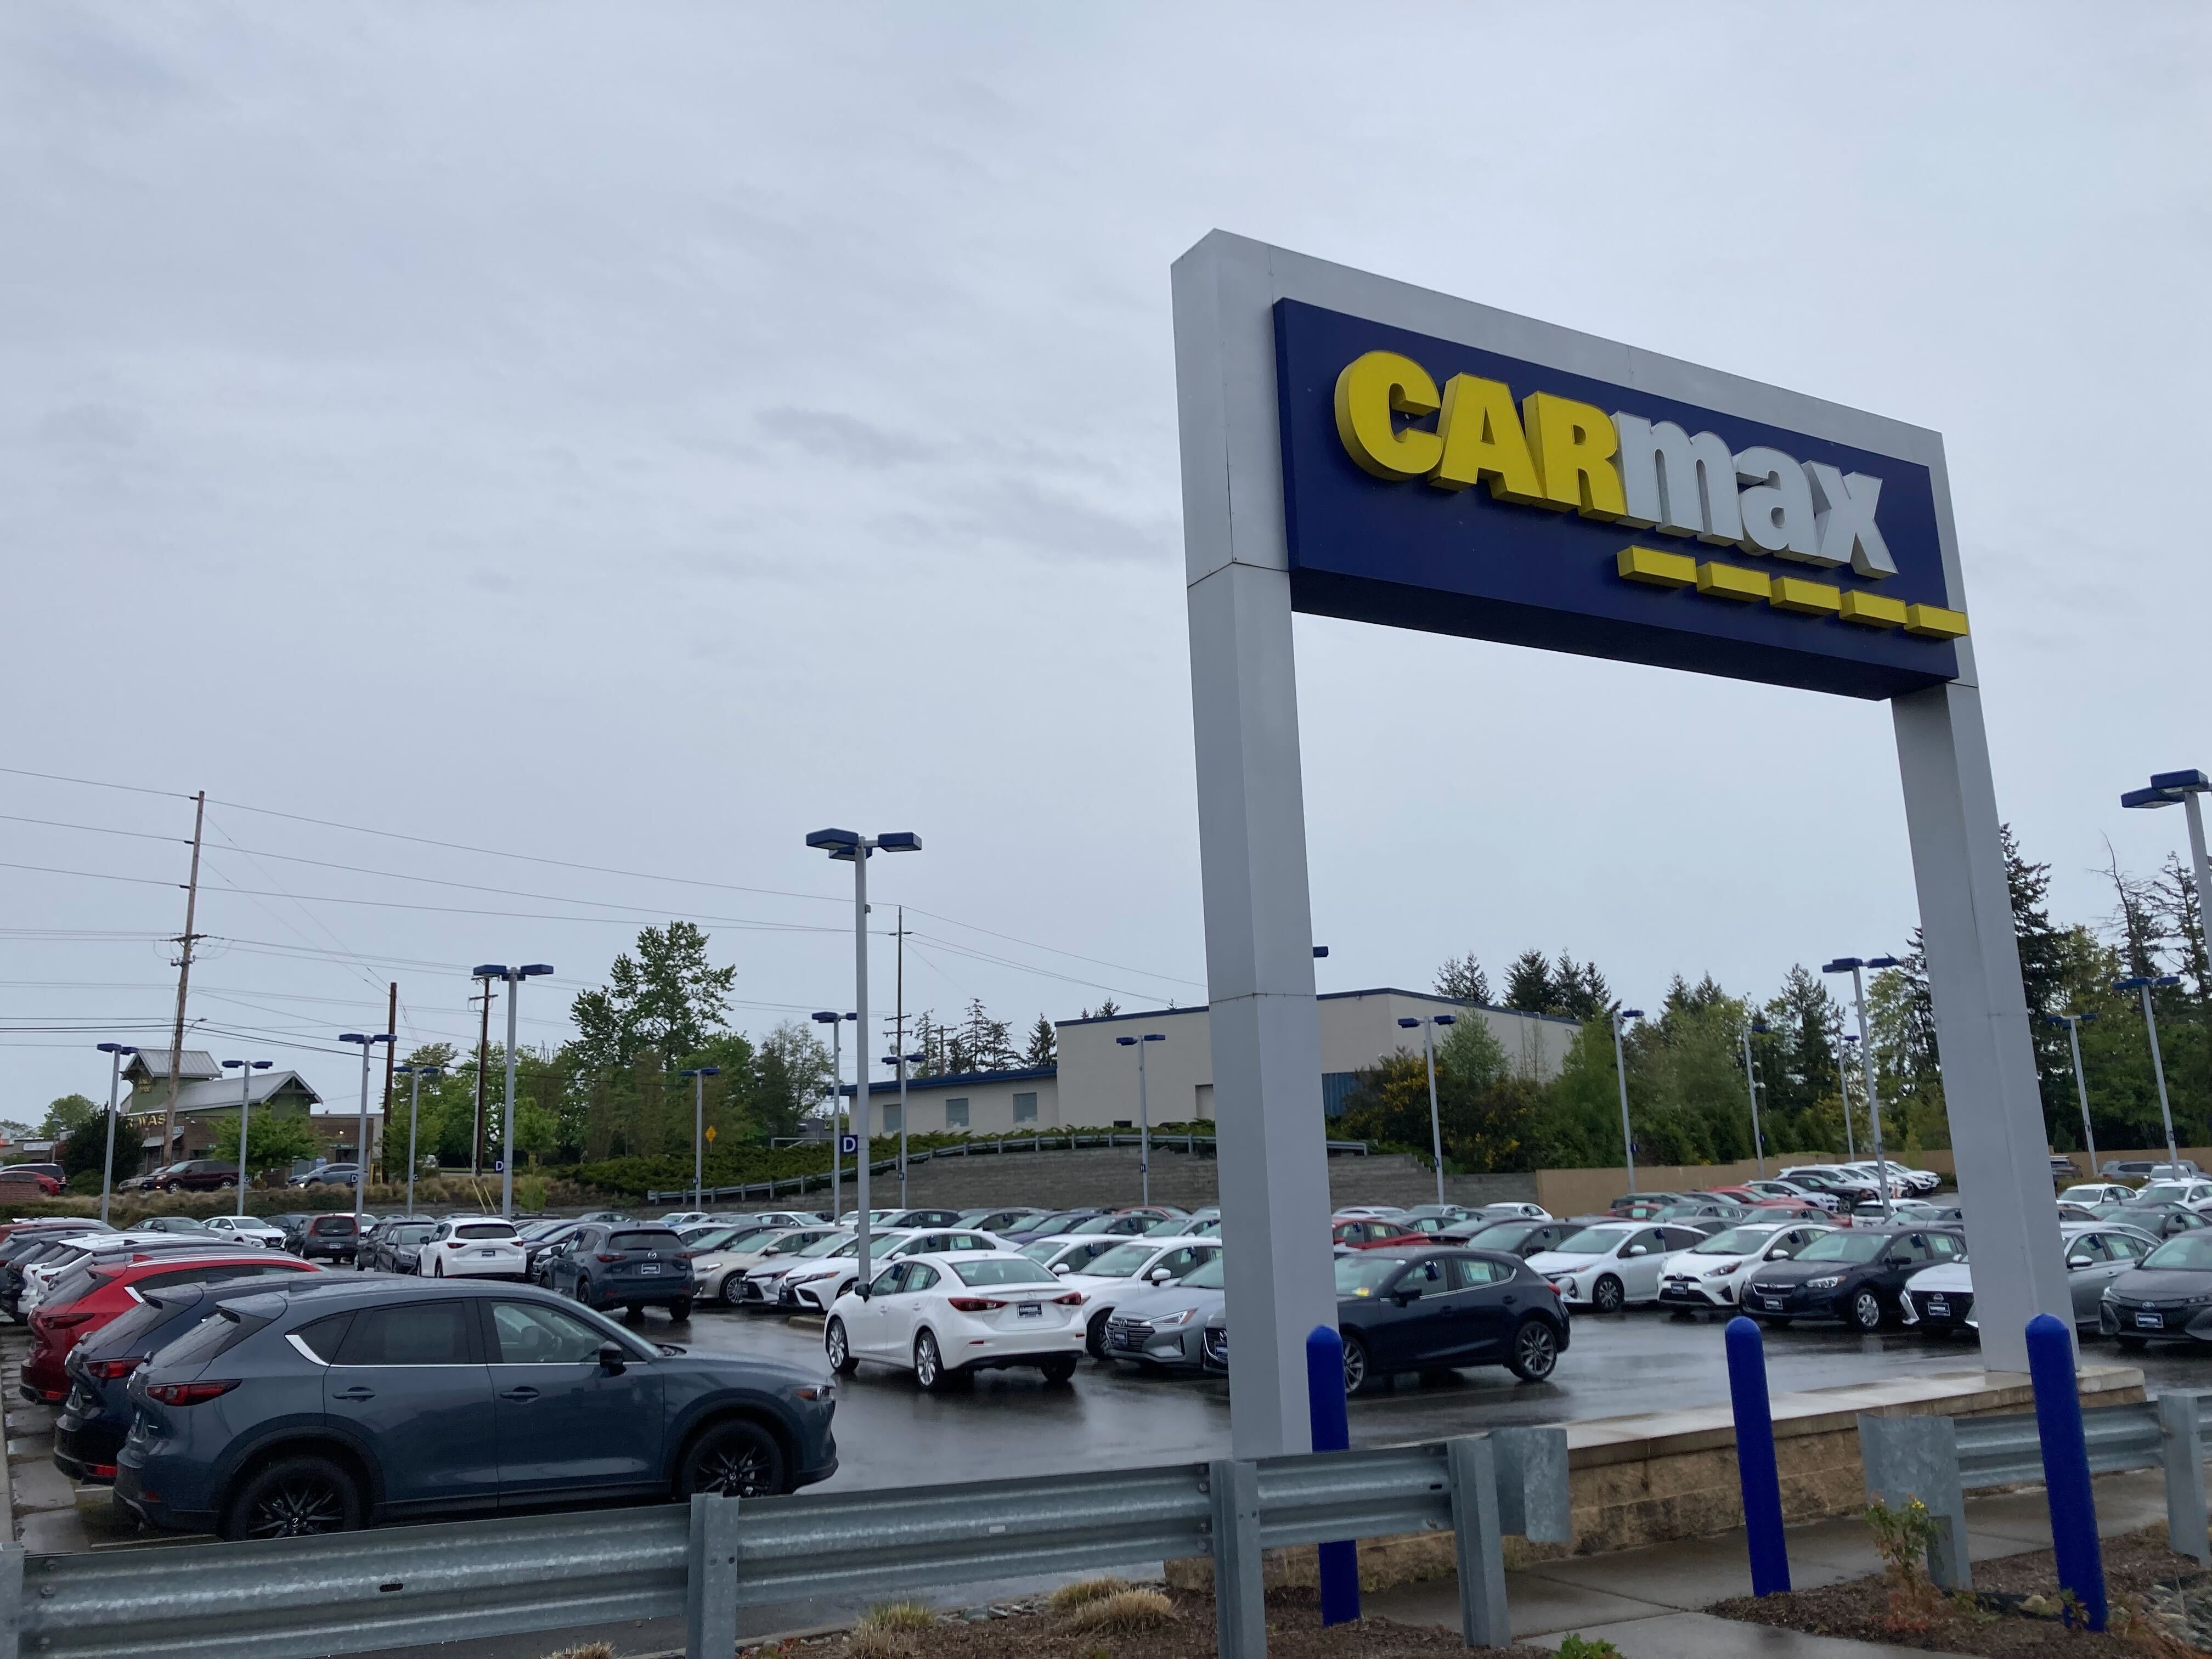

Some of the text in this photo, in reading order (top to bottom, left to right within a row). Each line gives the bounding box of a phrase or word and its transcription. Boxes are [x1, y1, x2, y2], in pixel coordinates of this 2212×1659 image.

[1334, 349, 1899, 579] CARmax
[138, 1114, 166, 1128] WAS
[843, 1137, 856, 1153] D
[495, 1160, 504, 1171] D
